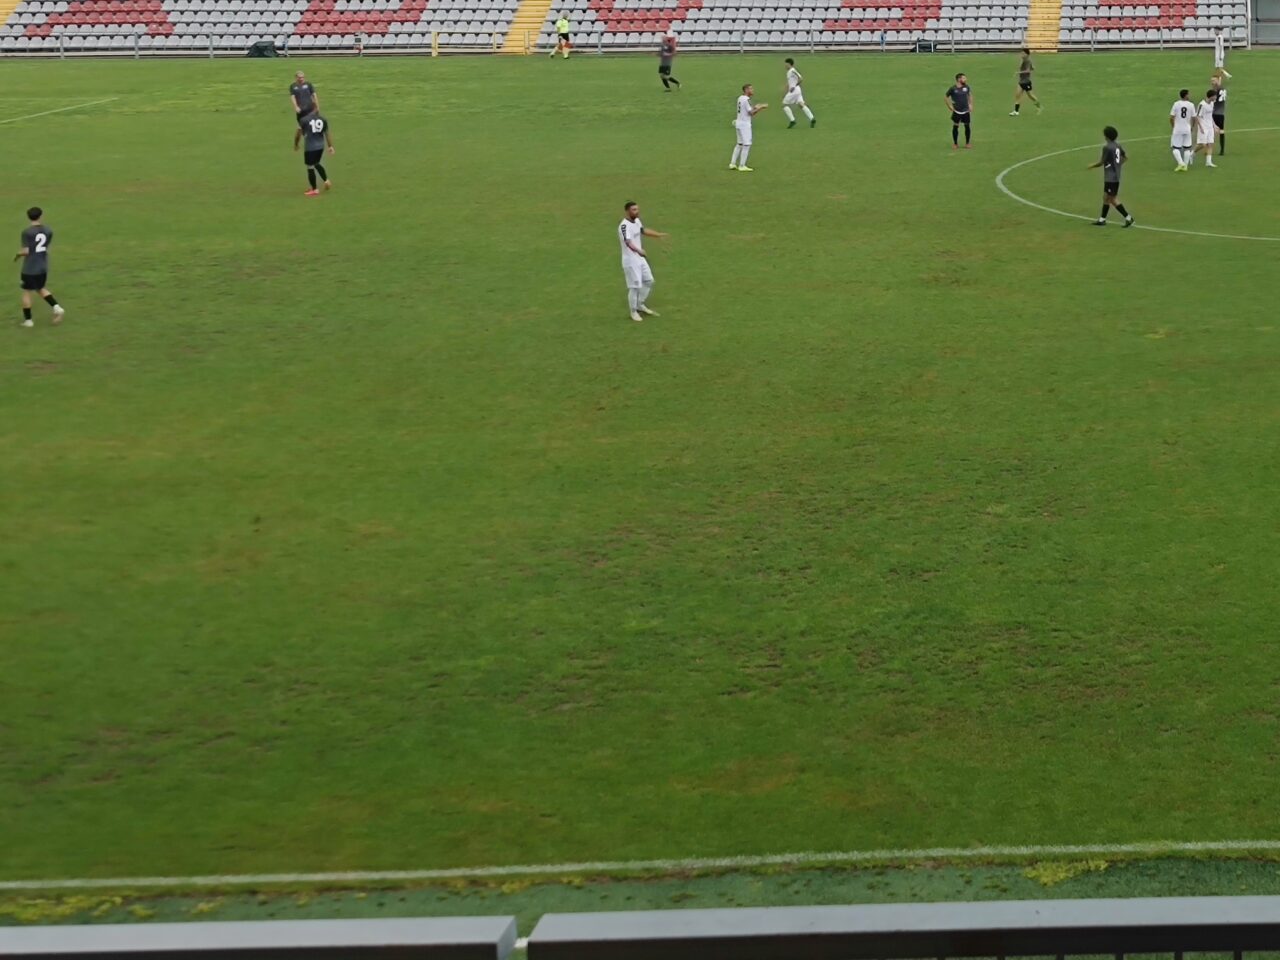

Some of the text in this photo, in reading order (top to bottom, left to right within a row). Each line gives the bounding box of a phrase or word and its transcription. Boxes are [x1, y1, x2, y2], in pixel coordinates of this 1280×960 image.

[1180, 106, 1188, 119] 8
[309, 119, 324, 133] 19
[35, 232, 47, 253] 2
